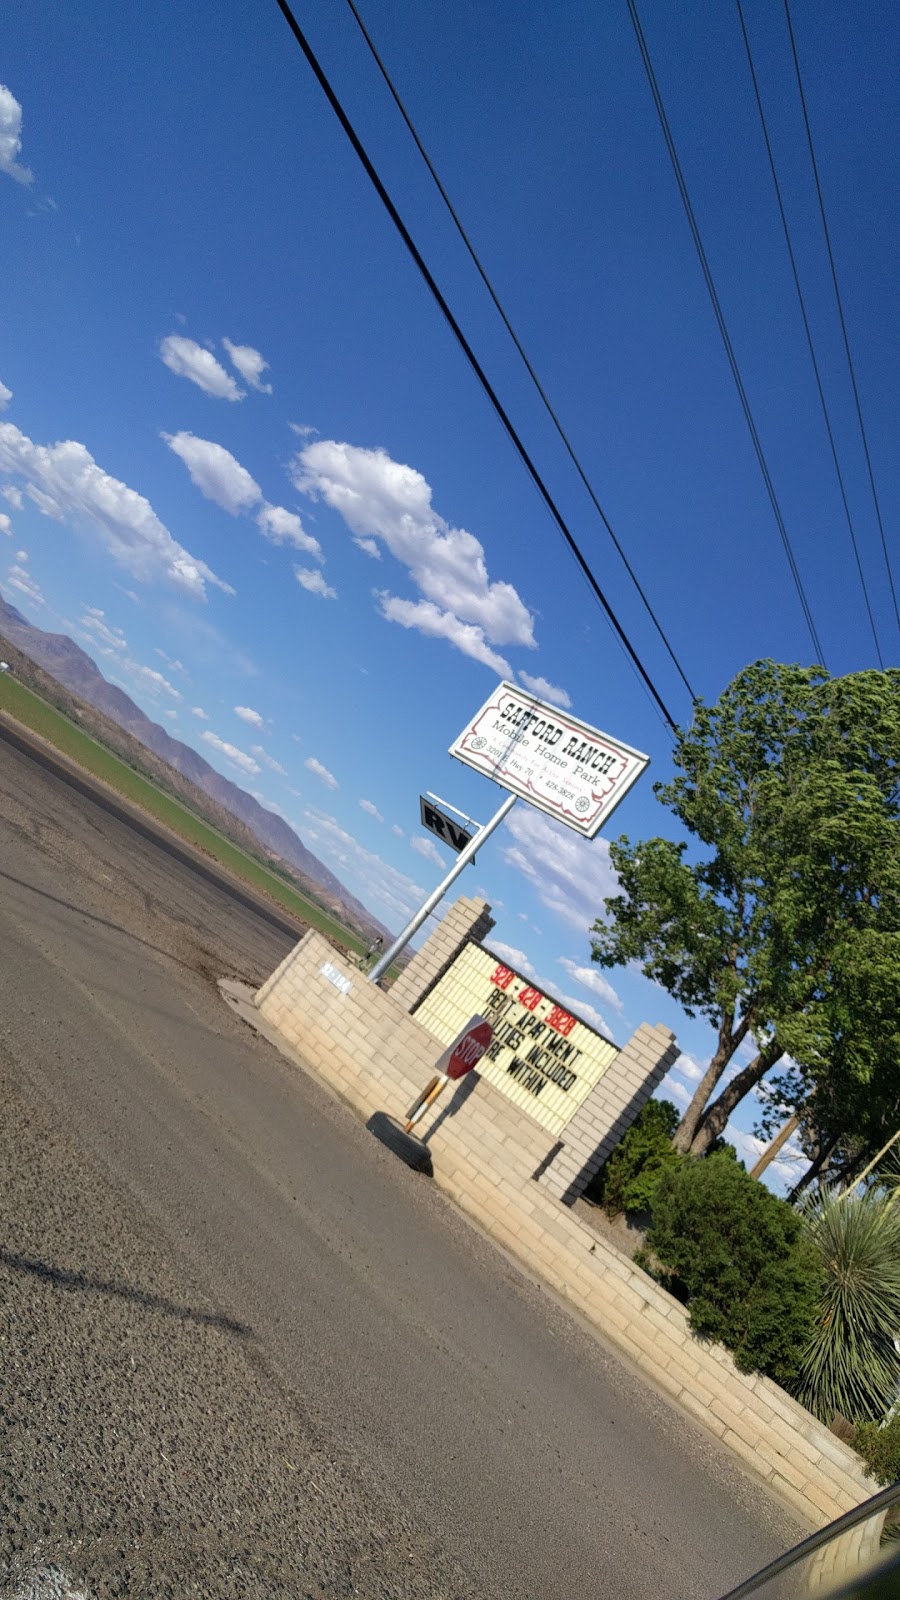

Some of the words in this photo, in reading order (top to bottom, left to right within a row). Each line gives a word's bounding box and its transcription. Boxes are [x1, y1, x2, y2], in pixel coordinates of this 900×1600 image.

[491, 721, 530, 747] Mobile
[534, 744, 568, 769] Home
[572, 765, 601, 787] Park
[500, 703, 563, 746] SAFFORD
[562, 735, 616, 775] RANCH
[486, 745, 503, 759] 3201
[510, 759, 524, 773] Hwy
[524, 765, 534, 777] 70
[545, 780, 575, 801] 428-3828
[424, 805, 469, 851] RV
[454, 1036, 486, 1065] STOP
[516, 1012, 582, 1067] APARTMENT
[506, 1056, 548, 1097] WITHIN
[525, 1045, 577, 1092] INCLUDED
